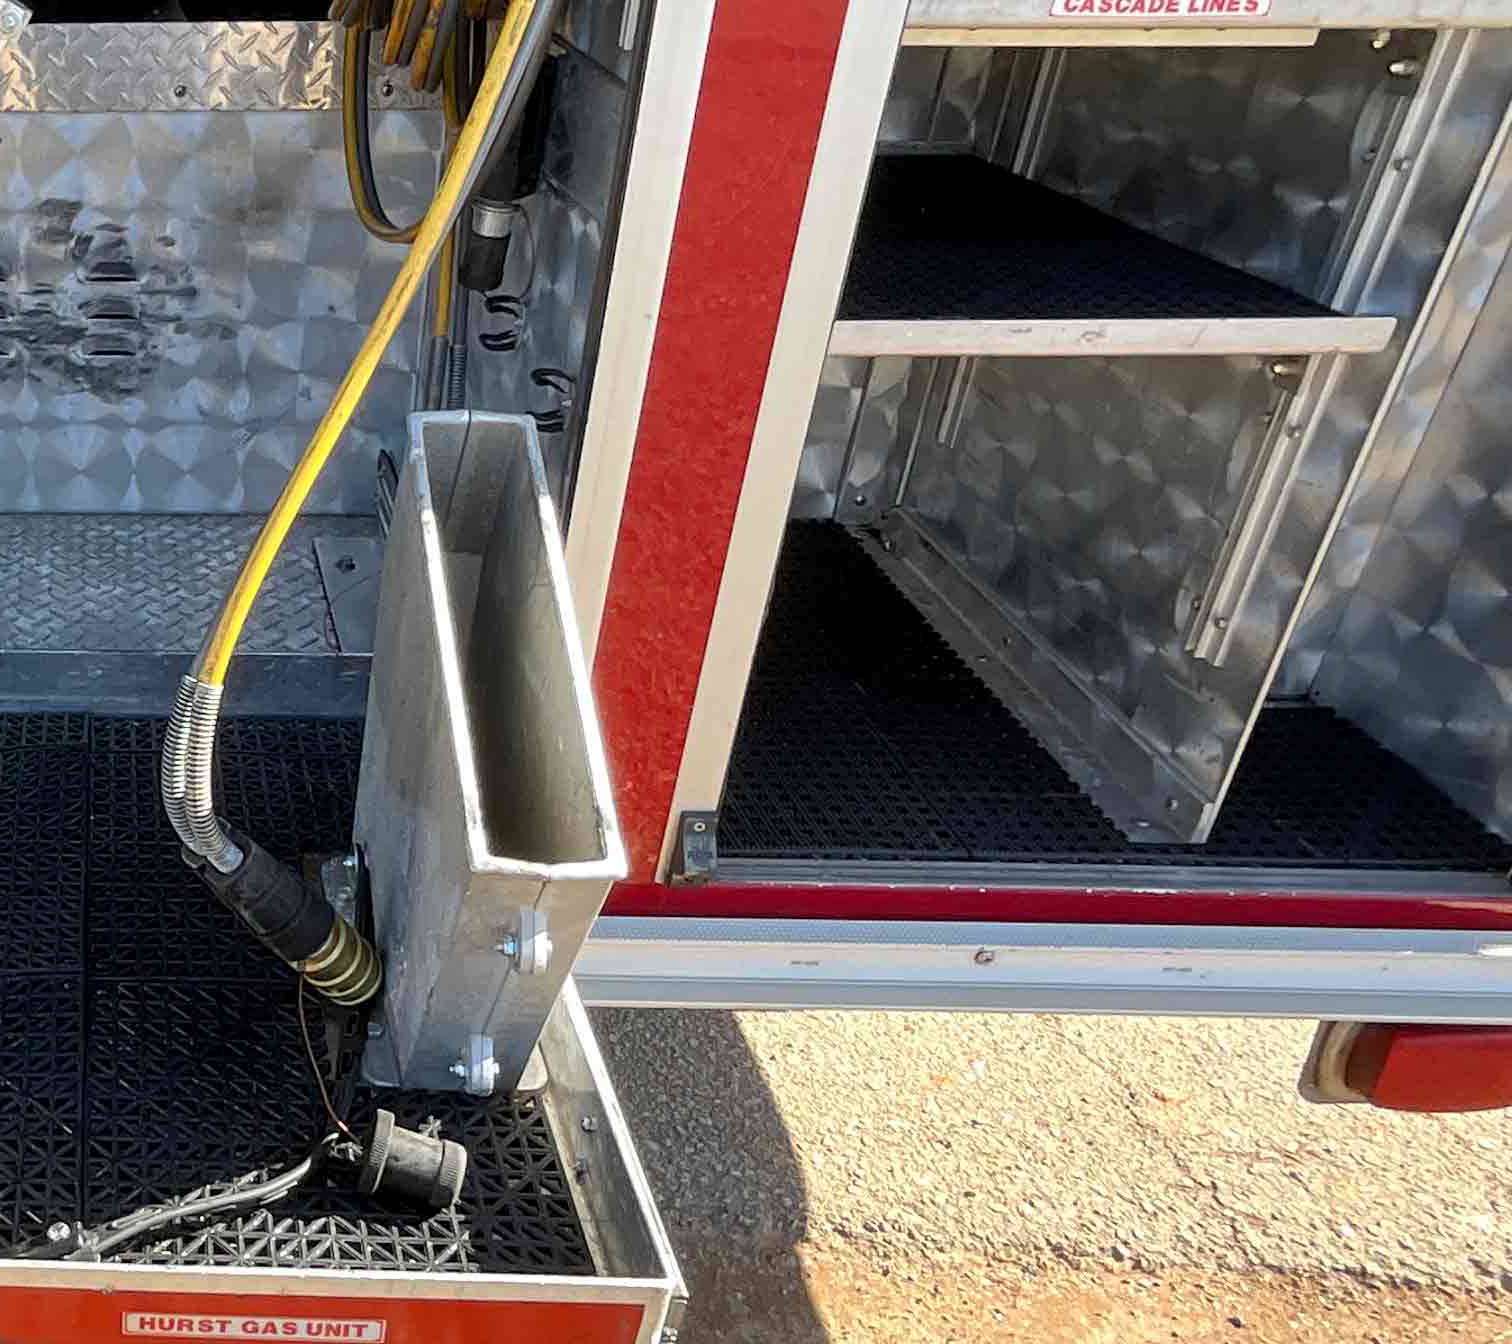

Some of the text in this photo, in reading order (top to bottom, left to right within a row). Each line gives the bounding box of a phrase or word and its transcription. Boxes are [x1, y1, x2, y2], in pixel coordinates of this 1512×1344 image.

[138, 1316, 369, 1337] HURST GAS UNIT
